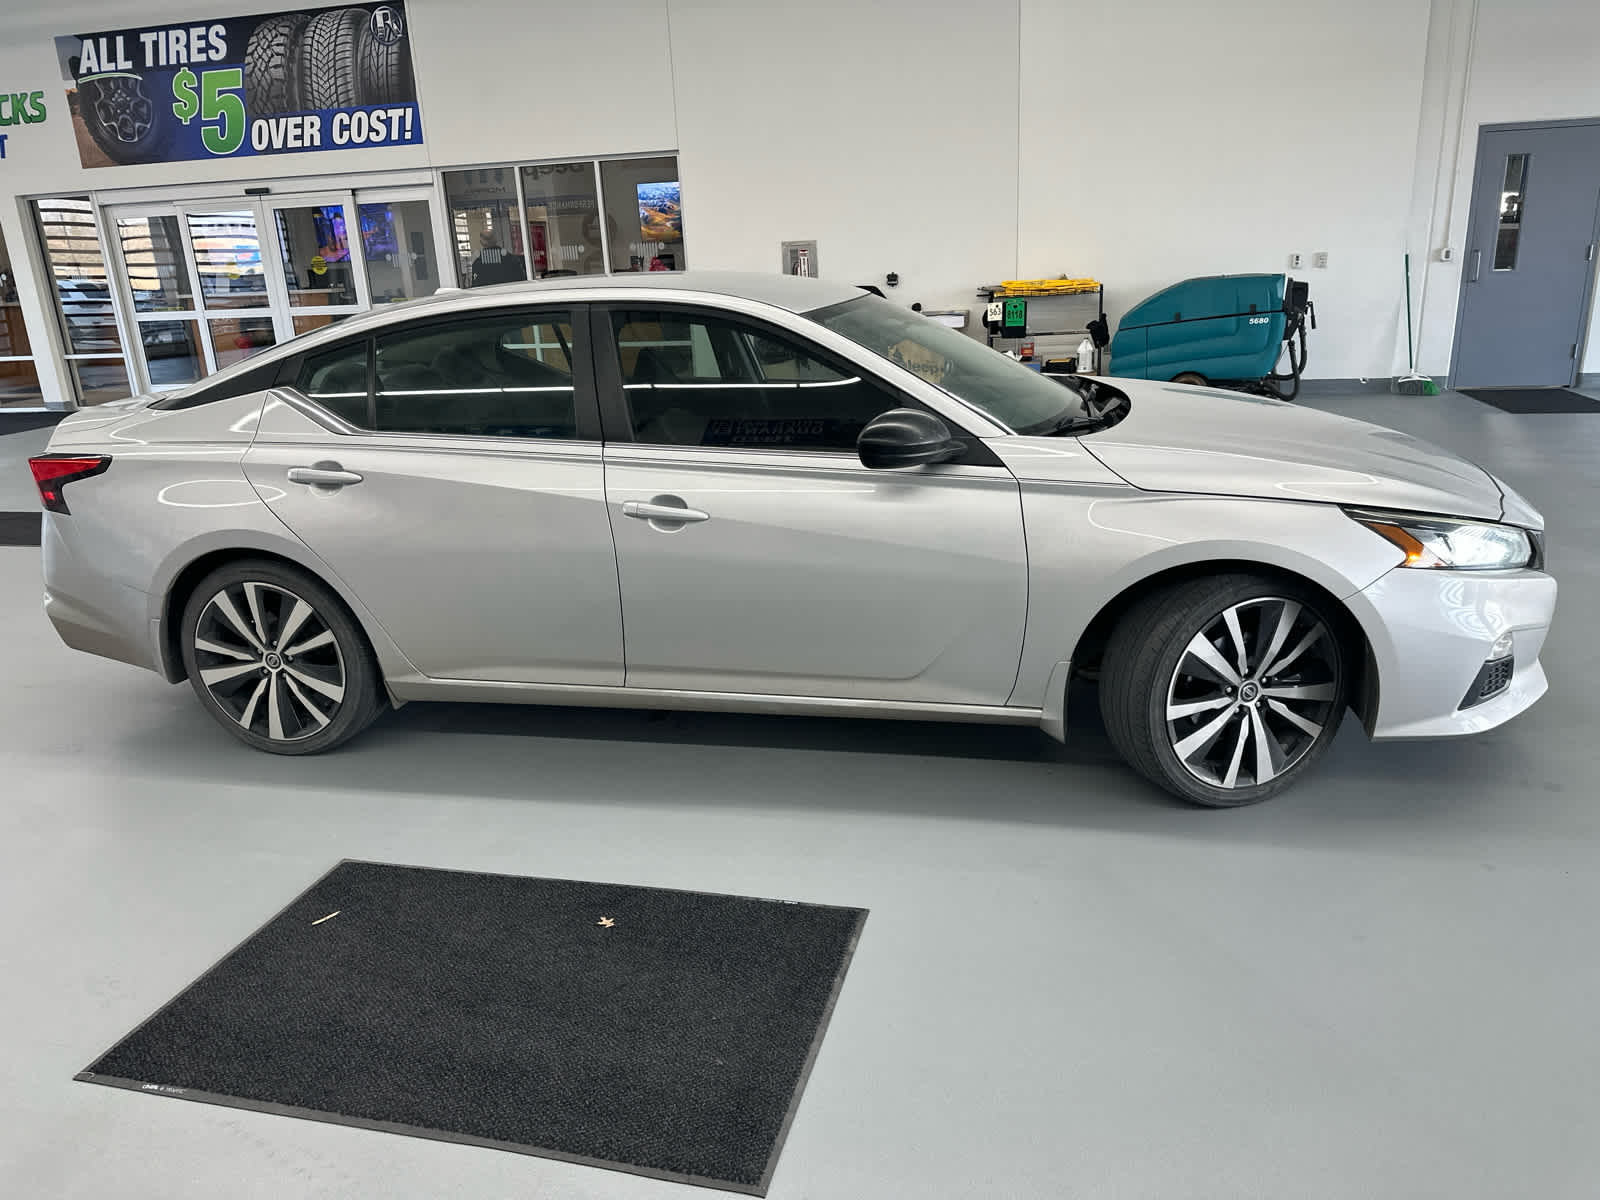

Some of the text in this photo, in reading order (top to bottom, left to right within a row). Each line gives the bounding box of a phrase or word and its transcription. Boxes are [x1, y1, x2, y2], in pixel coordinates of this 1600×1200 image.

[79, 24, 227, 74] ALL TIRES
[172, 67, 246, 155] $5
[251, 107, 413, 151] OVER COST!
[1249, 317, 1269, 325] 5680
